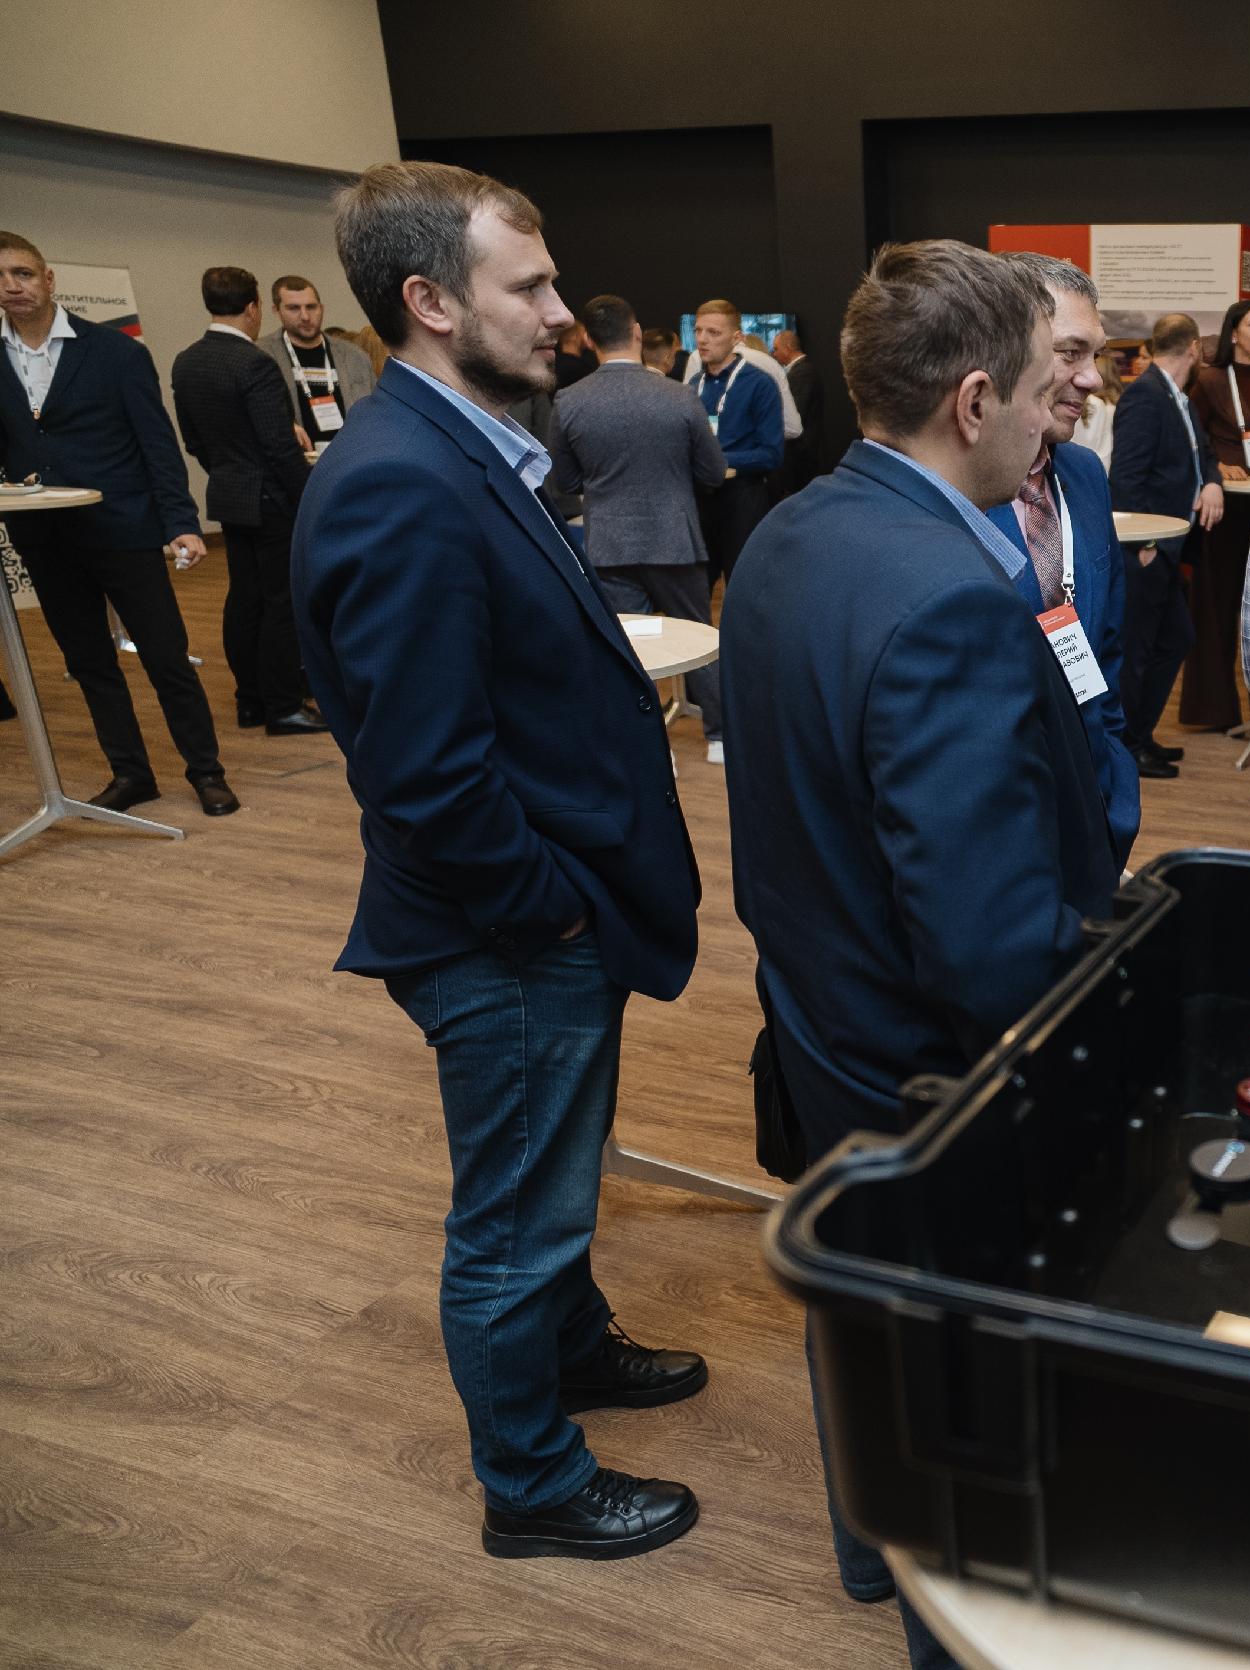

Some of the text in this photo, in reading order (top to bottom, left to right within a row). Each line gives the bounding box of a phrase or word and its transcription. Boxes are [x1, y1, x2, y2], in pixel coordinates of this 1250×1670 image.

[53, 293, 128, 305] ОГАТИТЕЛЬНОЕ
[1050, 633, 1077, 649] АНОВИЧ
[1056, 642, 1078, 659] ЛЕРИЙ
[1062, 651, 1088, 668] АВОВИЧ
